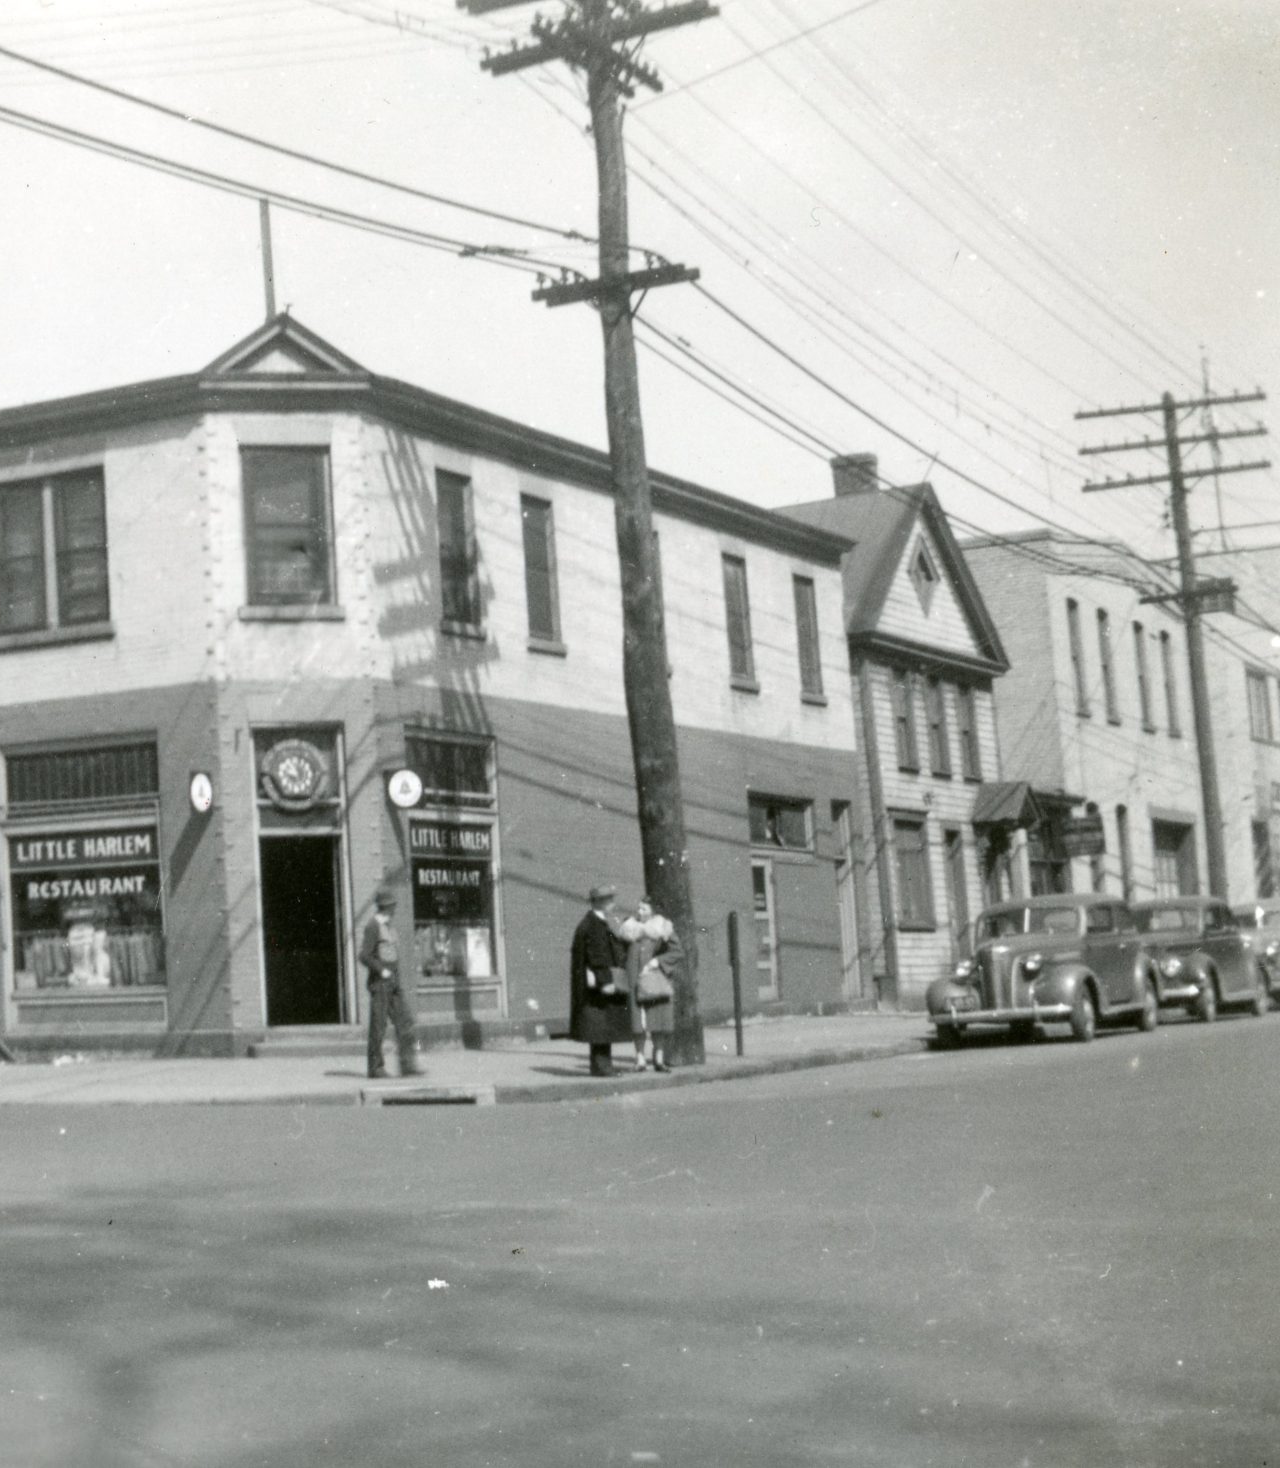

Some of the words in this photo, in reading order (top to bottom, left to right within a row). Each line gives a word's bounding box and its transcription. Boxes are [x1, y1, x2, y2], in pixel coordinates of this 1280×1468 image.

[17, 839, 76, 862] LITTLE
[84, 833, 150, 858] HARLEM
[411, 827, 447, 848] LITTLE
[450, 829, 490, 850] HARLEM
[28, 875, 145, 899] RESTAURANT
[418, 868, 480, 887] RESTAURANT
